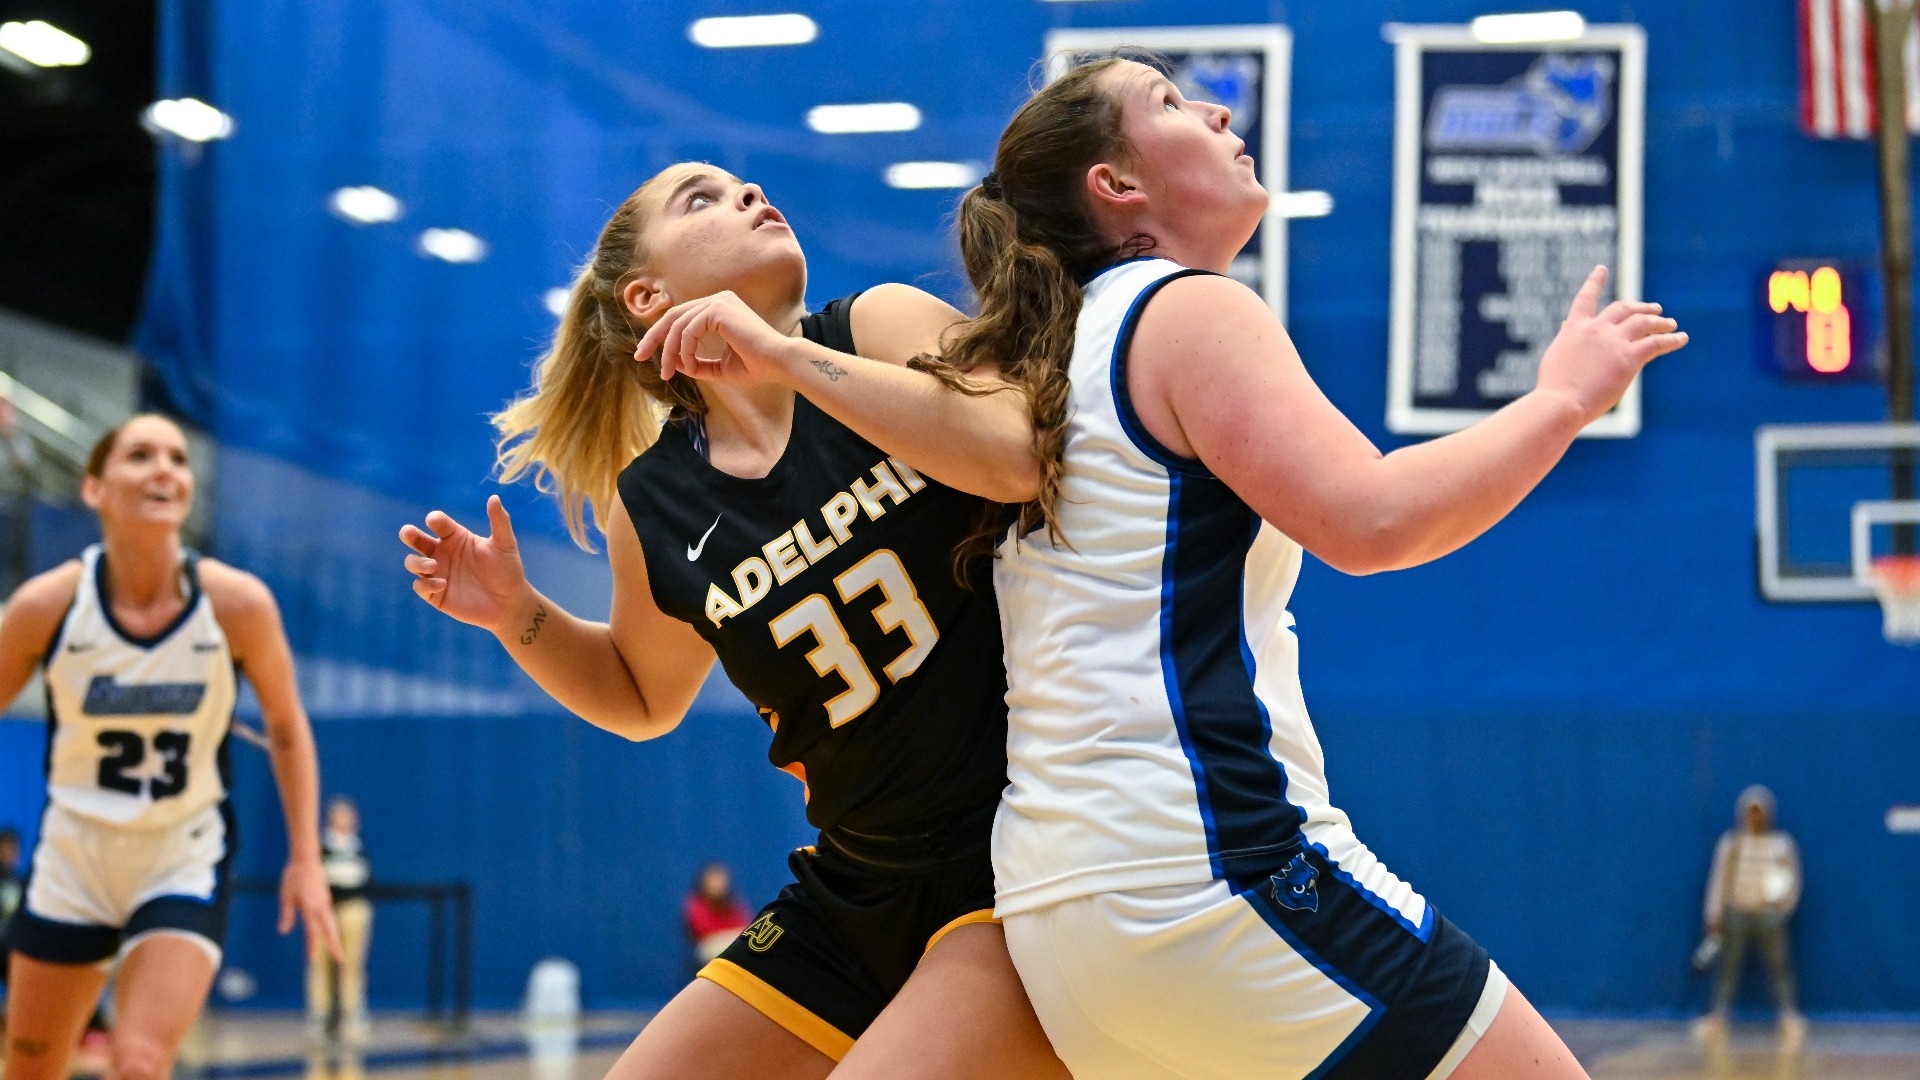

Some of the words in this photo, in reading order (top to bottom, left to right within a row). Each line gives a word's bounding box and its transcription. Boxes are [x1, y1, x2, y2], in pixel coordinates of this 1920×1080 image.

[705, 456, 927, 629] ADELPHI
[768, 548, 940, 729] 33
[96, 729, 192, 801] 23
